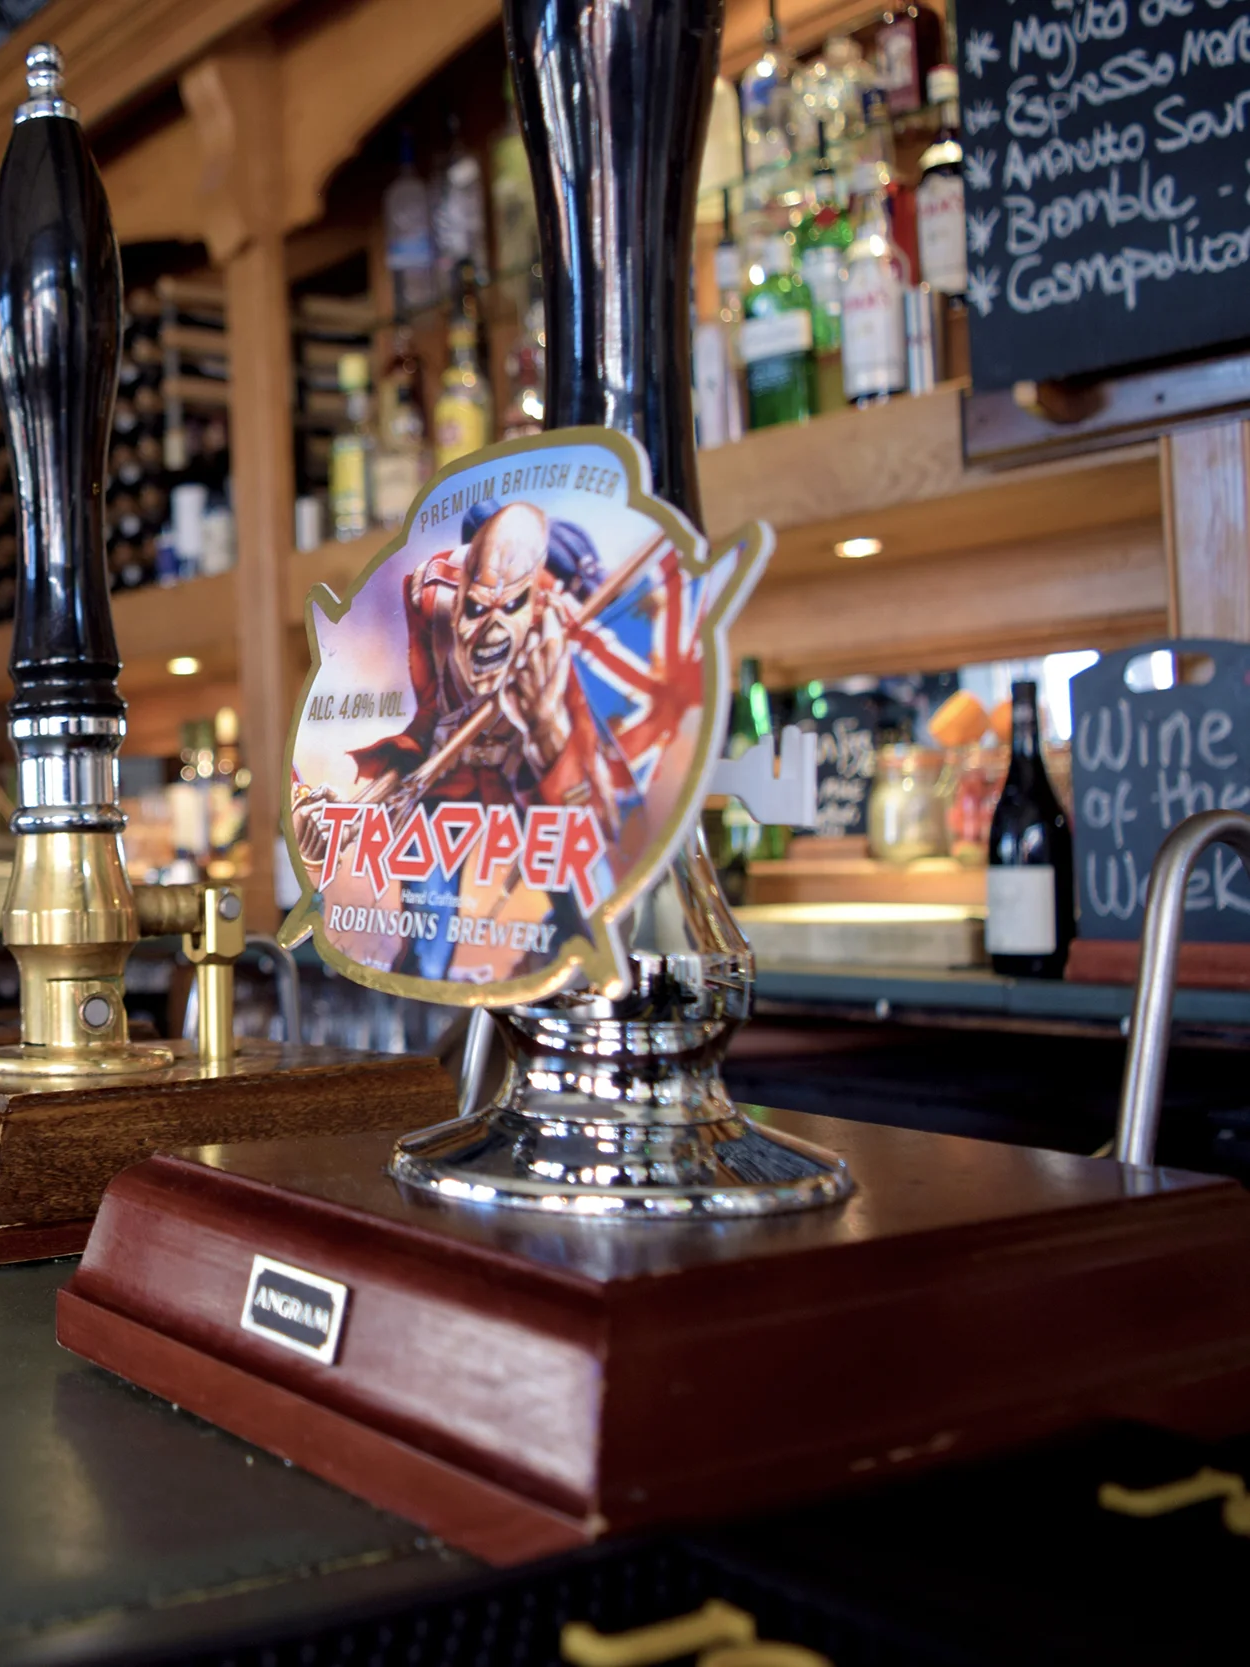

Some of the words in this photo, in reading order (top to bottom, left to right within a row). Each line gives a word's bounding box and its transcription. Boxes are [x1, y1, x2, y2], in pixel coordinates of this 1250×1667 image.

[420, 475, 496, 532] PREMIUM
[501, 463, 571, 496] BRITISH
[574, 464, 622, 499] BEER
[307, 695, 335, 721] ALC.
[338, 692, 375, 719] 4.8%
[378, 691, 407, 718] VOL.
[1076, 698, 1238, 773] Wine
[1083, 779, 1137, 849] of
[318, 801, 607, 918] TROOPER
[329, 905, 439, 941] ROBINSONS
[446, 916, 557, 953] BREWERY
[253, 1285, 330, 1335] ANGRAM
